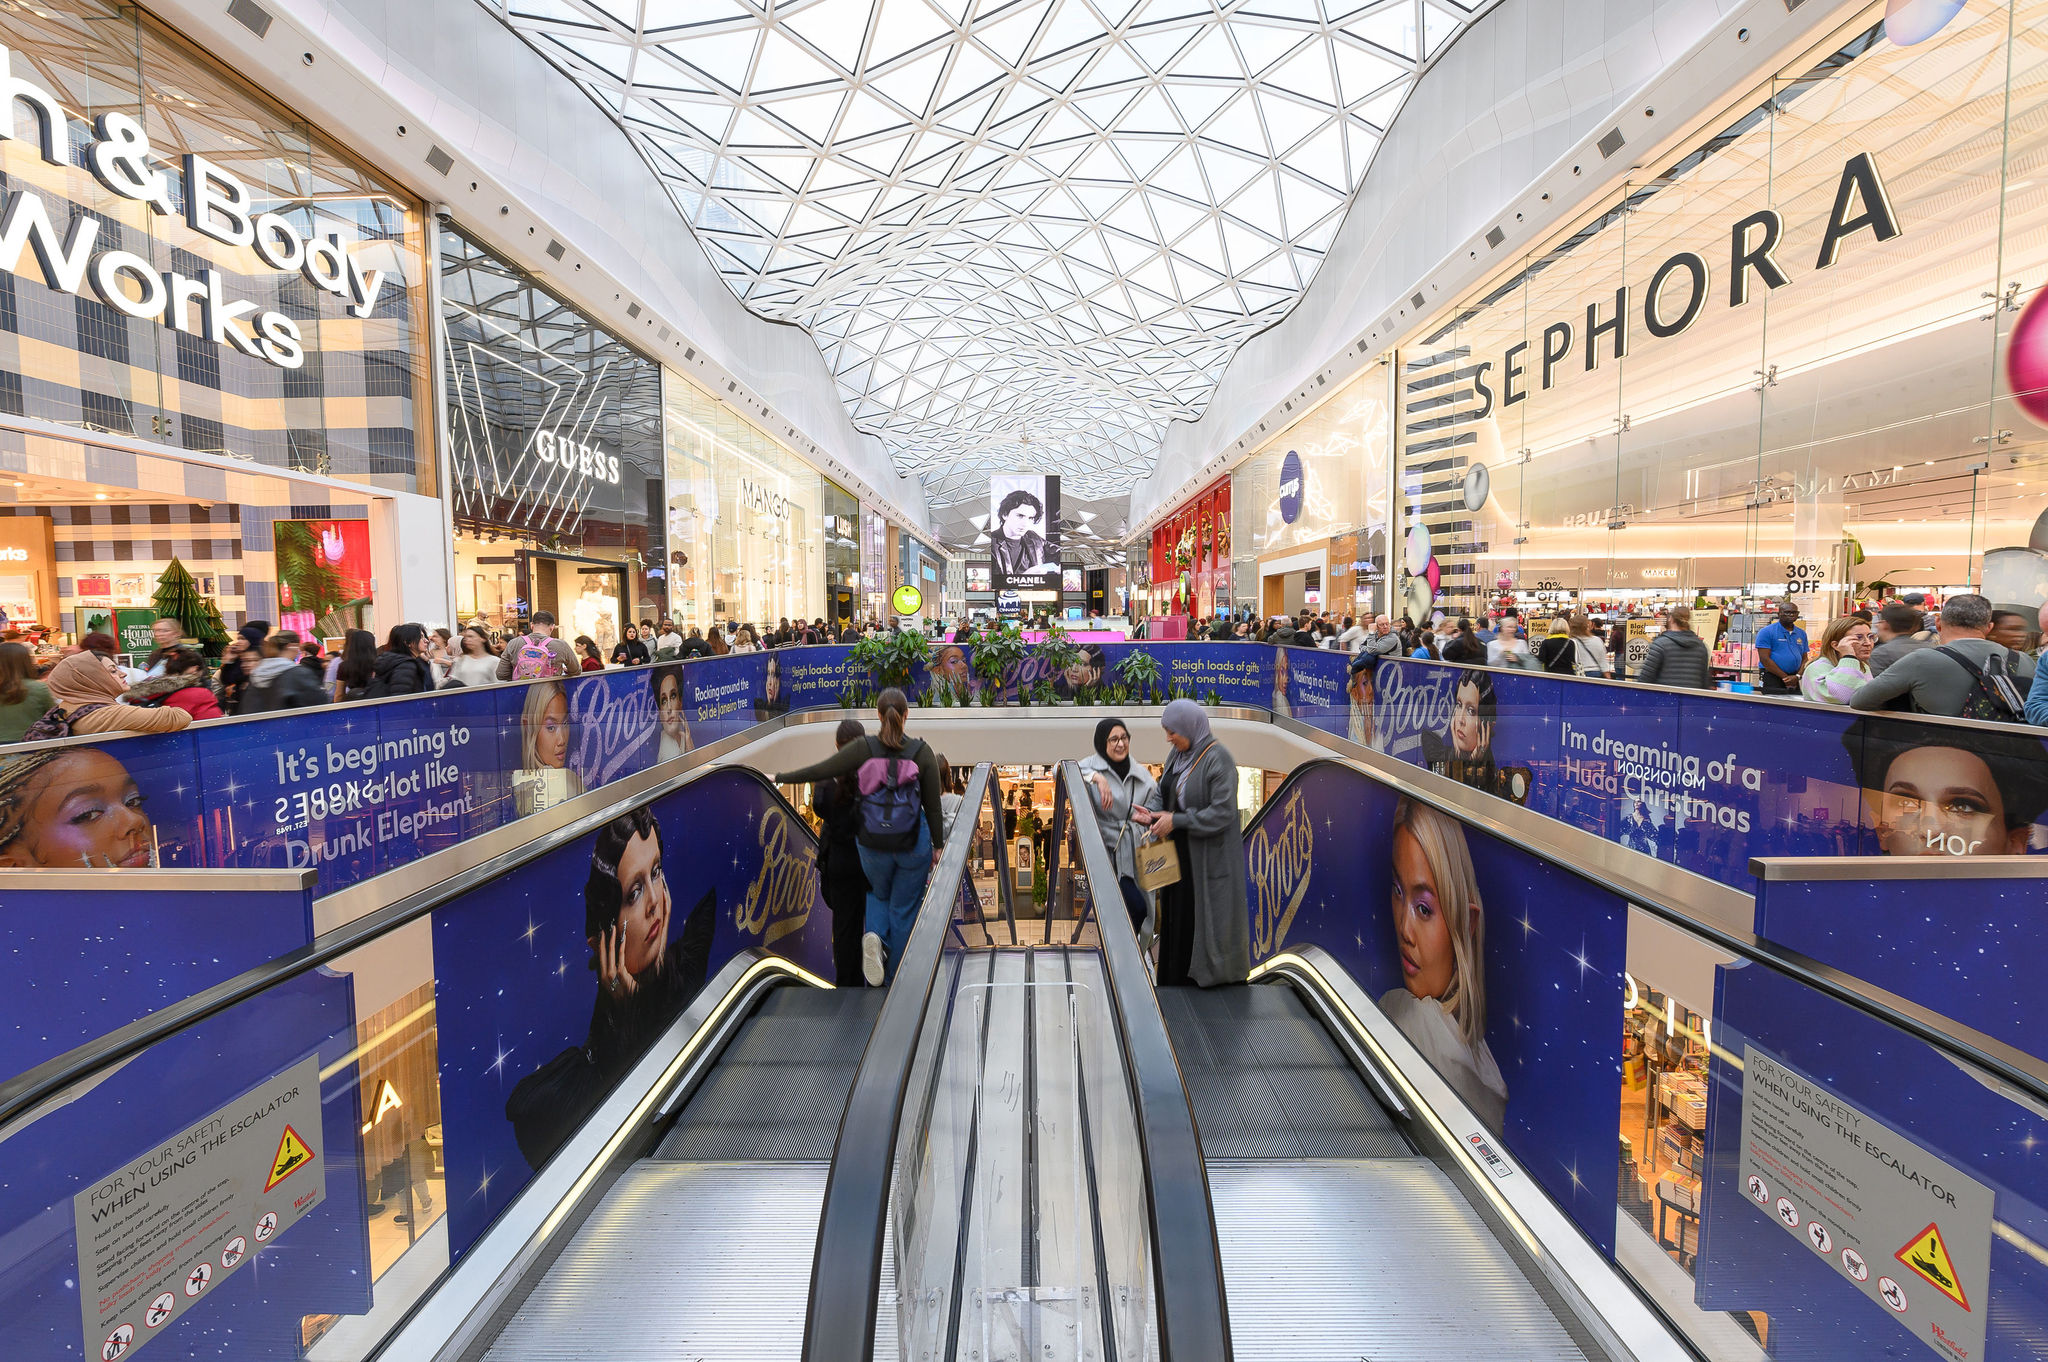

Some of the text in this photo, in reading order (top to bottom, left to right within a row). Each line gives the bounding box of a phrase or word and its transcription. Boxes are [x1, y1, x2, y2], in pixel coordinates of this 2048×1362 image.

[88, 112, 177, 216] &
[184, 153, 385, 319] Body
[0, 191, 304, 369] Works
[1474, 152, 1903, 420] SEPHORA
[535, 430, 620, 485] GUESS
[742, 478, 790, 520] MANGO
[1279, 477, 1300, 499] currys
[1006, 576, 1046, 585] CHANEL
[1537, 581, 1563, 592] 30%
[1643, 569, 1677, 578] MAKEU
[1785, 564, 1825, 578] 30%
[1787, 580, 1820, 594] OFF
[1537, 592, 1561, 602] OFF
[121, 629, 155, 639] HOLIDAY
[126, 638, 152, 649] STORY
[1629, 644, 1650, 653] 30%
[695, 677, 749, 702] Rocking around the
[791, 676, 872, 694] only one floor down
[808, 663, 833, 675] loads
[835, 663, 845, 674] of
[1172, 659, 1205, 674] Sleigh
[1207, 660, 1234, 671] loads
[1236, 661, 1246, 672] of
[1246, 662, 1259, 675] gifts
[1172, 673, 1259, 688] only one floor down
[1293, 669, 1312, 689] Walking
[1313, 673, 1318, 686] in
[1323, 675, 1339, 692] Fenty
[697, 698, 747, 722] Sol de Janeiro tree
[1298, 687, 1330, 708] Wonderland
[1375, 660, 1455, 756] Boots
[570, 670, 660, 787] Boots
[277, 724, 471, 785] It's beginning to
[1562, 721, 1762, 792] I'm dreaming of a
[370, 782, 385, 802] a
[390, 771, 421, 799] lot
[424, 760, 459, 789] like
[1566, 756, 1751, 833] Huda Christmas
[286, 791, 473, 869] Drunk Elephant
[735, 805, 817, 948] Boots
[1249, 786, 1313, 961] Boots
[1753, 1056, 1860, 1128] FOR YOUR SAFETY
[91, 1087, 300, 1223] WHEN USING THE ESCALATOR
[91, 1114, 225, 1206] FOR YOUR SAFETY
[1752, 1070, 1957, 1209] WHEN USING THE ESCALATOR
[95, 1201, 150, 1242] Hold the handrail
[96, 1253, 115, 1271] Stand
[116, 1241, 135, 1258] facing
[135, 1224, 160, 1244] forward
[161, 1218, 170, 1226] on
[171, 1210, 180, 1220] the
[181, 1197, 199, 1213] centre
[200, 1191, 207, 1200] of
[207, 1186, 216, 1195] the
[96, 1204, 170, 1257] Step on and off carefully
[97, 1199, 208, 1279] keeping your feet away from the sides
[98, 1193, 235, 1293] Supervise children and hold small children firmly
[98, 1296, 110, 1307] No
[147, 1250, 174, 1272] shopping
[101, 1224, 237, 1329] Keep loose clothing away from the moving parts
[1930, 1321, 1969, 1359] Westfield
